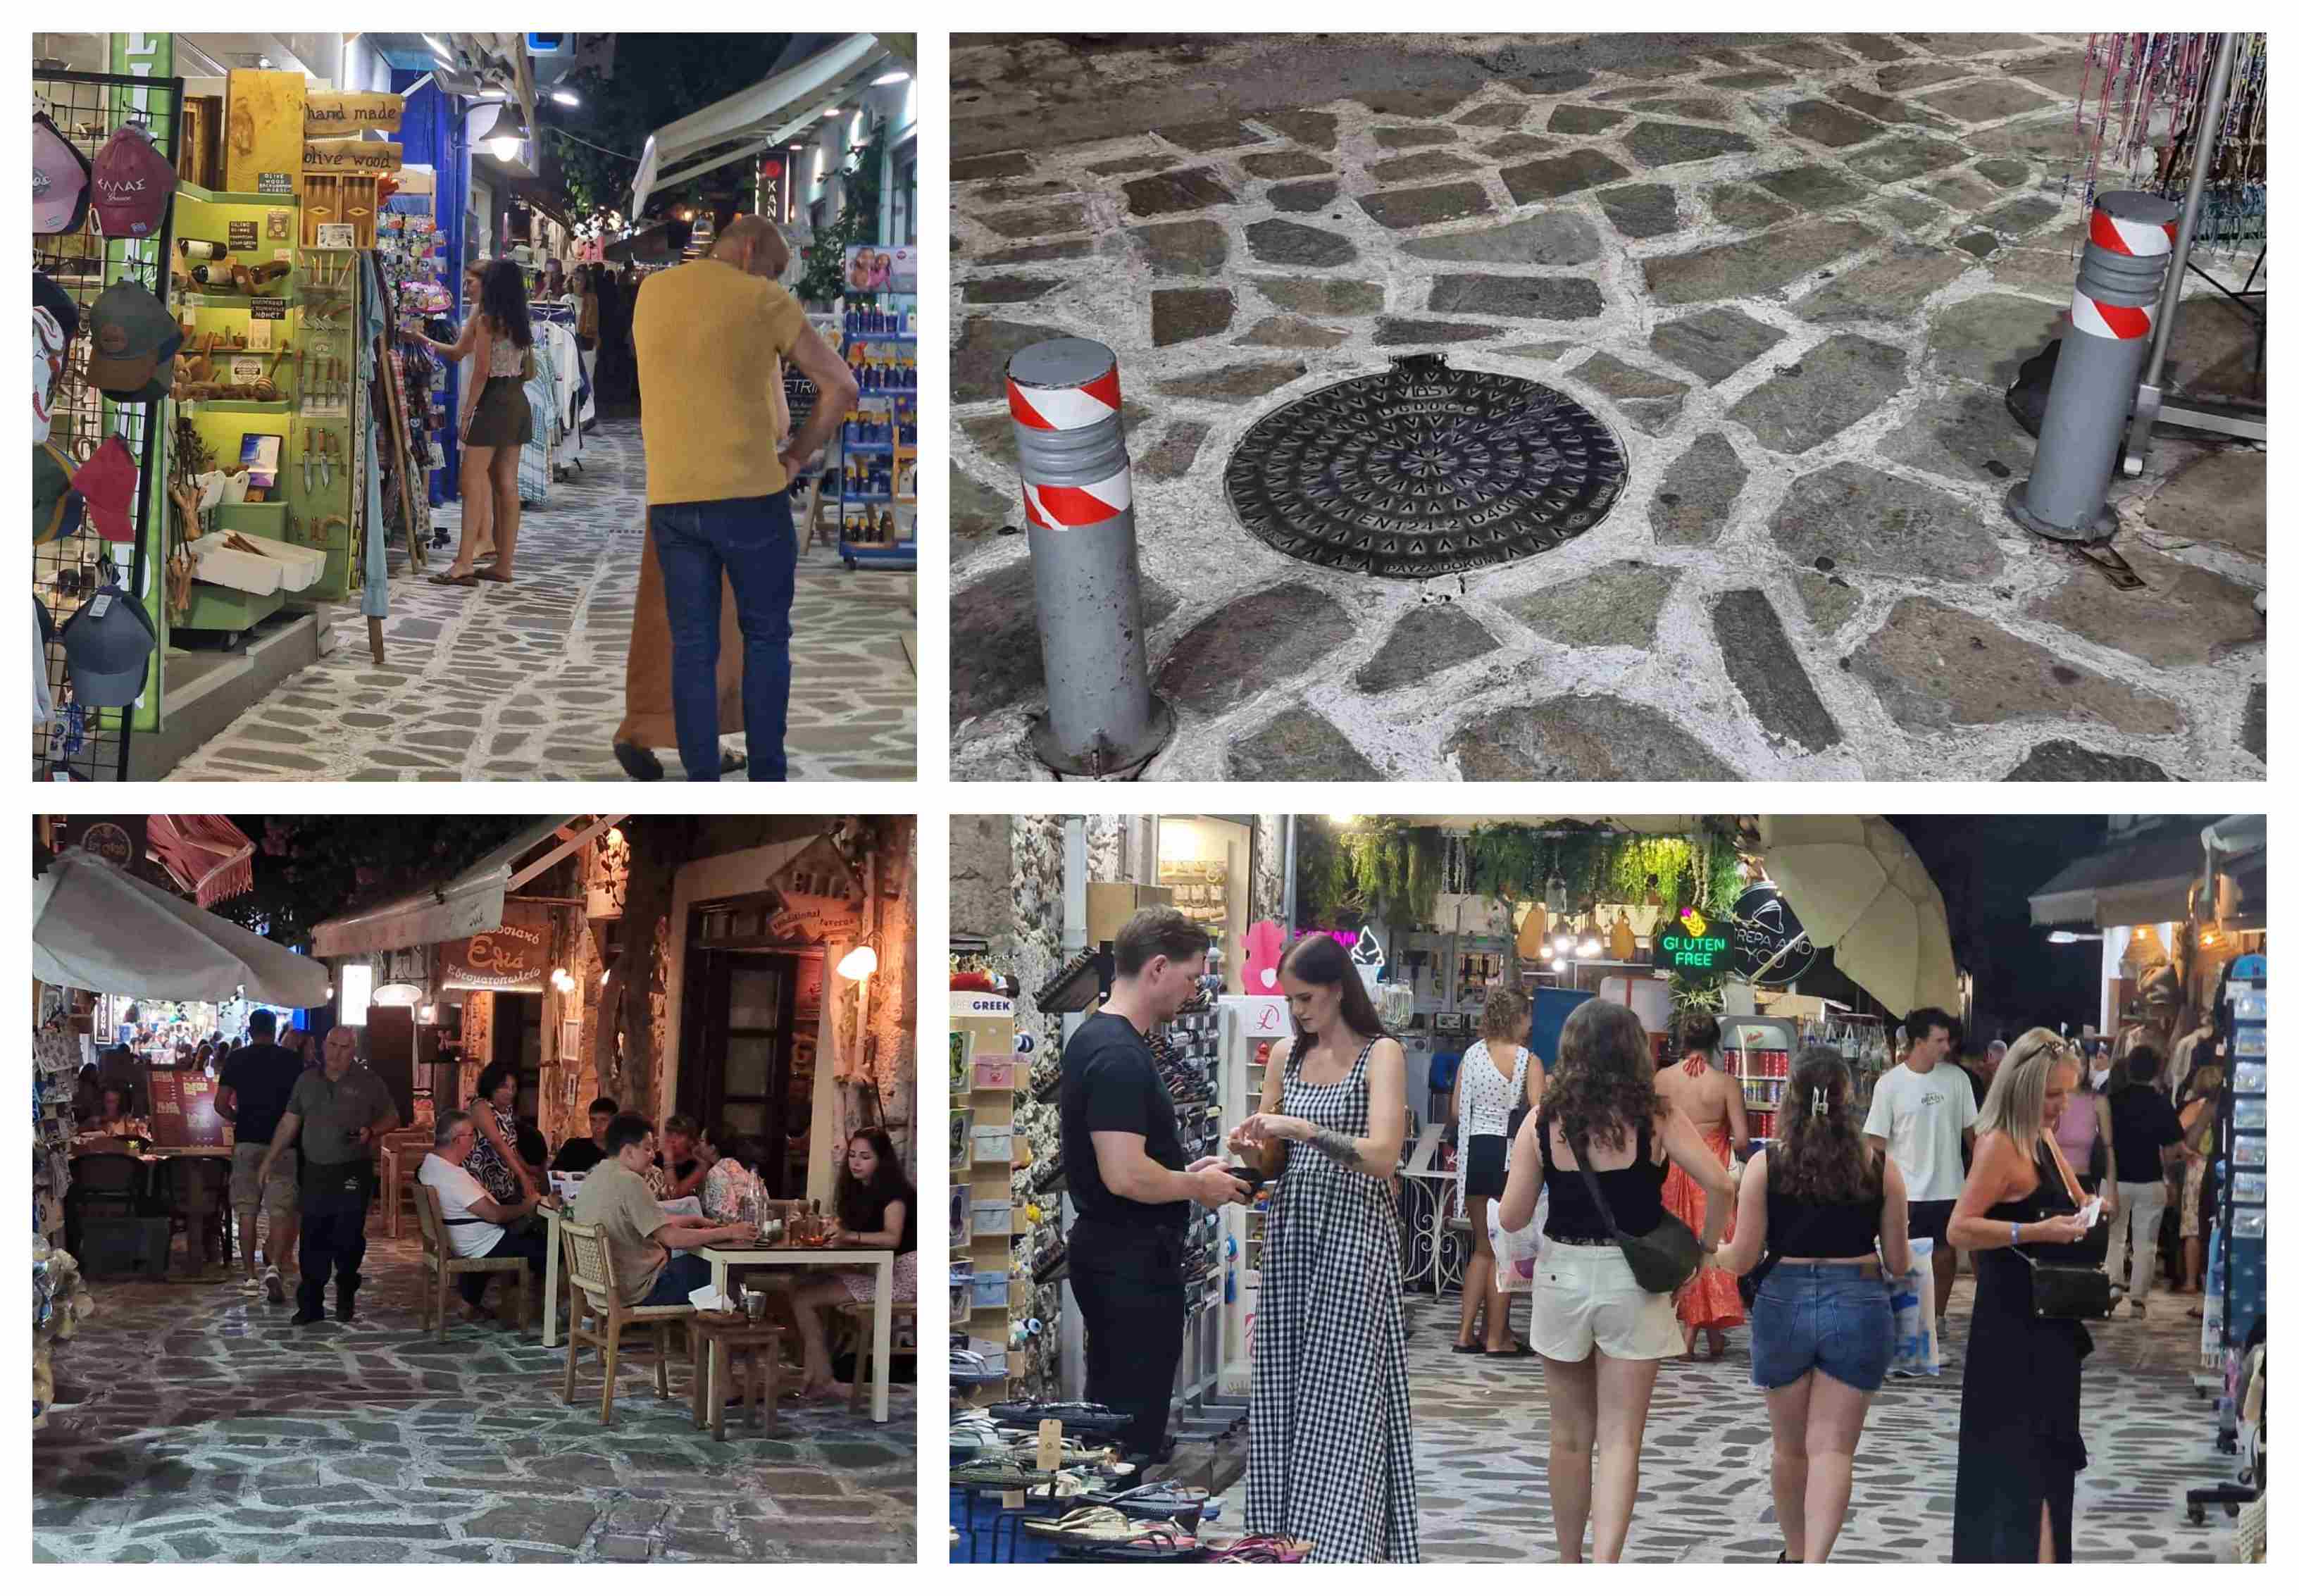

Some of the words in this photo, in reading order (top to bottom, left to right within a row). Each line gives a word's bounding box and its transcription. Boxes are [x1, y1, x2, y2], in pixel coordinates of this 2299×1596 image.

[304, 101, 345, 120] hand
[354, 101, 397, 120] made
[304, 146, 344, 165] olive
[353, 151, 391, 168] wood
[1663, 937, 1726, 951] GLUTEN
[1735, 928, 1772, 948] REPA
[1675, 953, 1713, 966] FREE
[447, 964, 540, 985] Εδεσματοπωλείο
[973, 1001, 1010, 1011] GREEK
